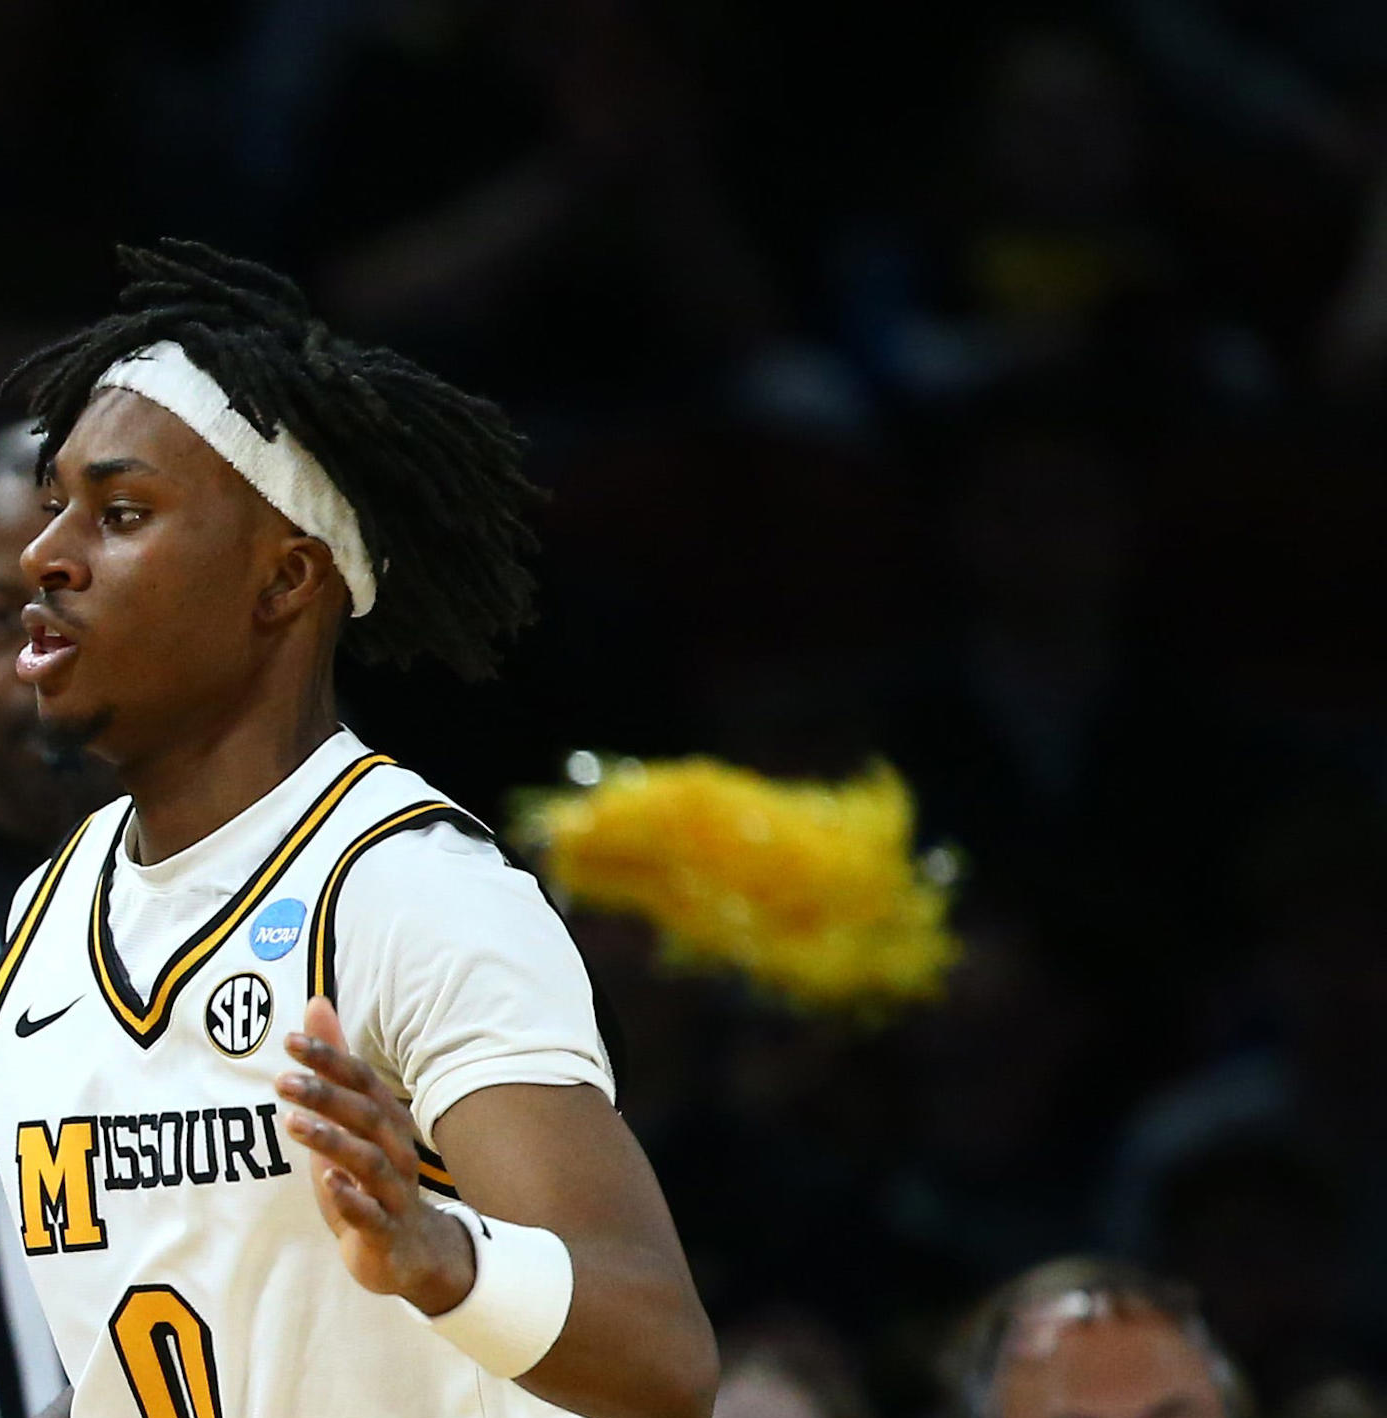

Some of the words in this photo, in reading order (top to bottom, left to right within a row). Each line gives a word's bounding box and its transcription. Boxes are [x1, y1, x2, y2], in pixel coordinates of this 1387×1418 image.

[255, 924, 300, 945] NCAA
[211, 979, 268, 1050] SEC
[16, 1104, 292, 1256] MISSOURI
